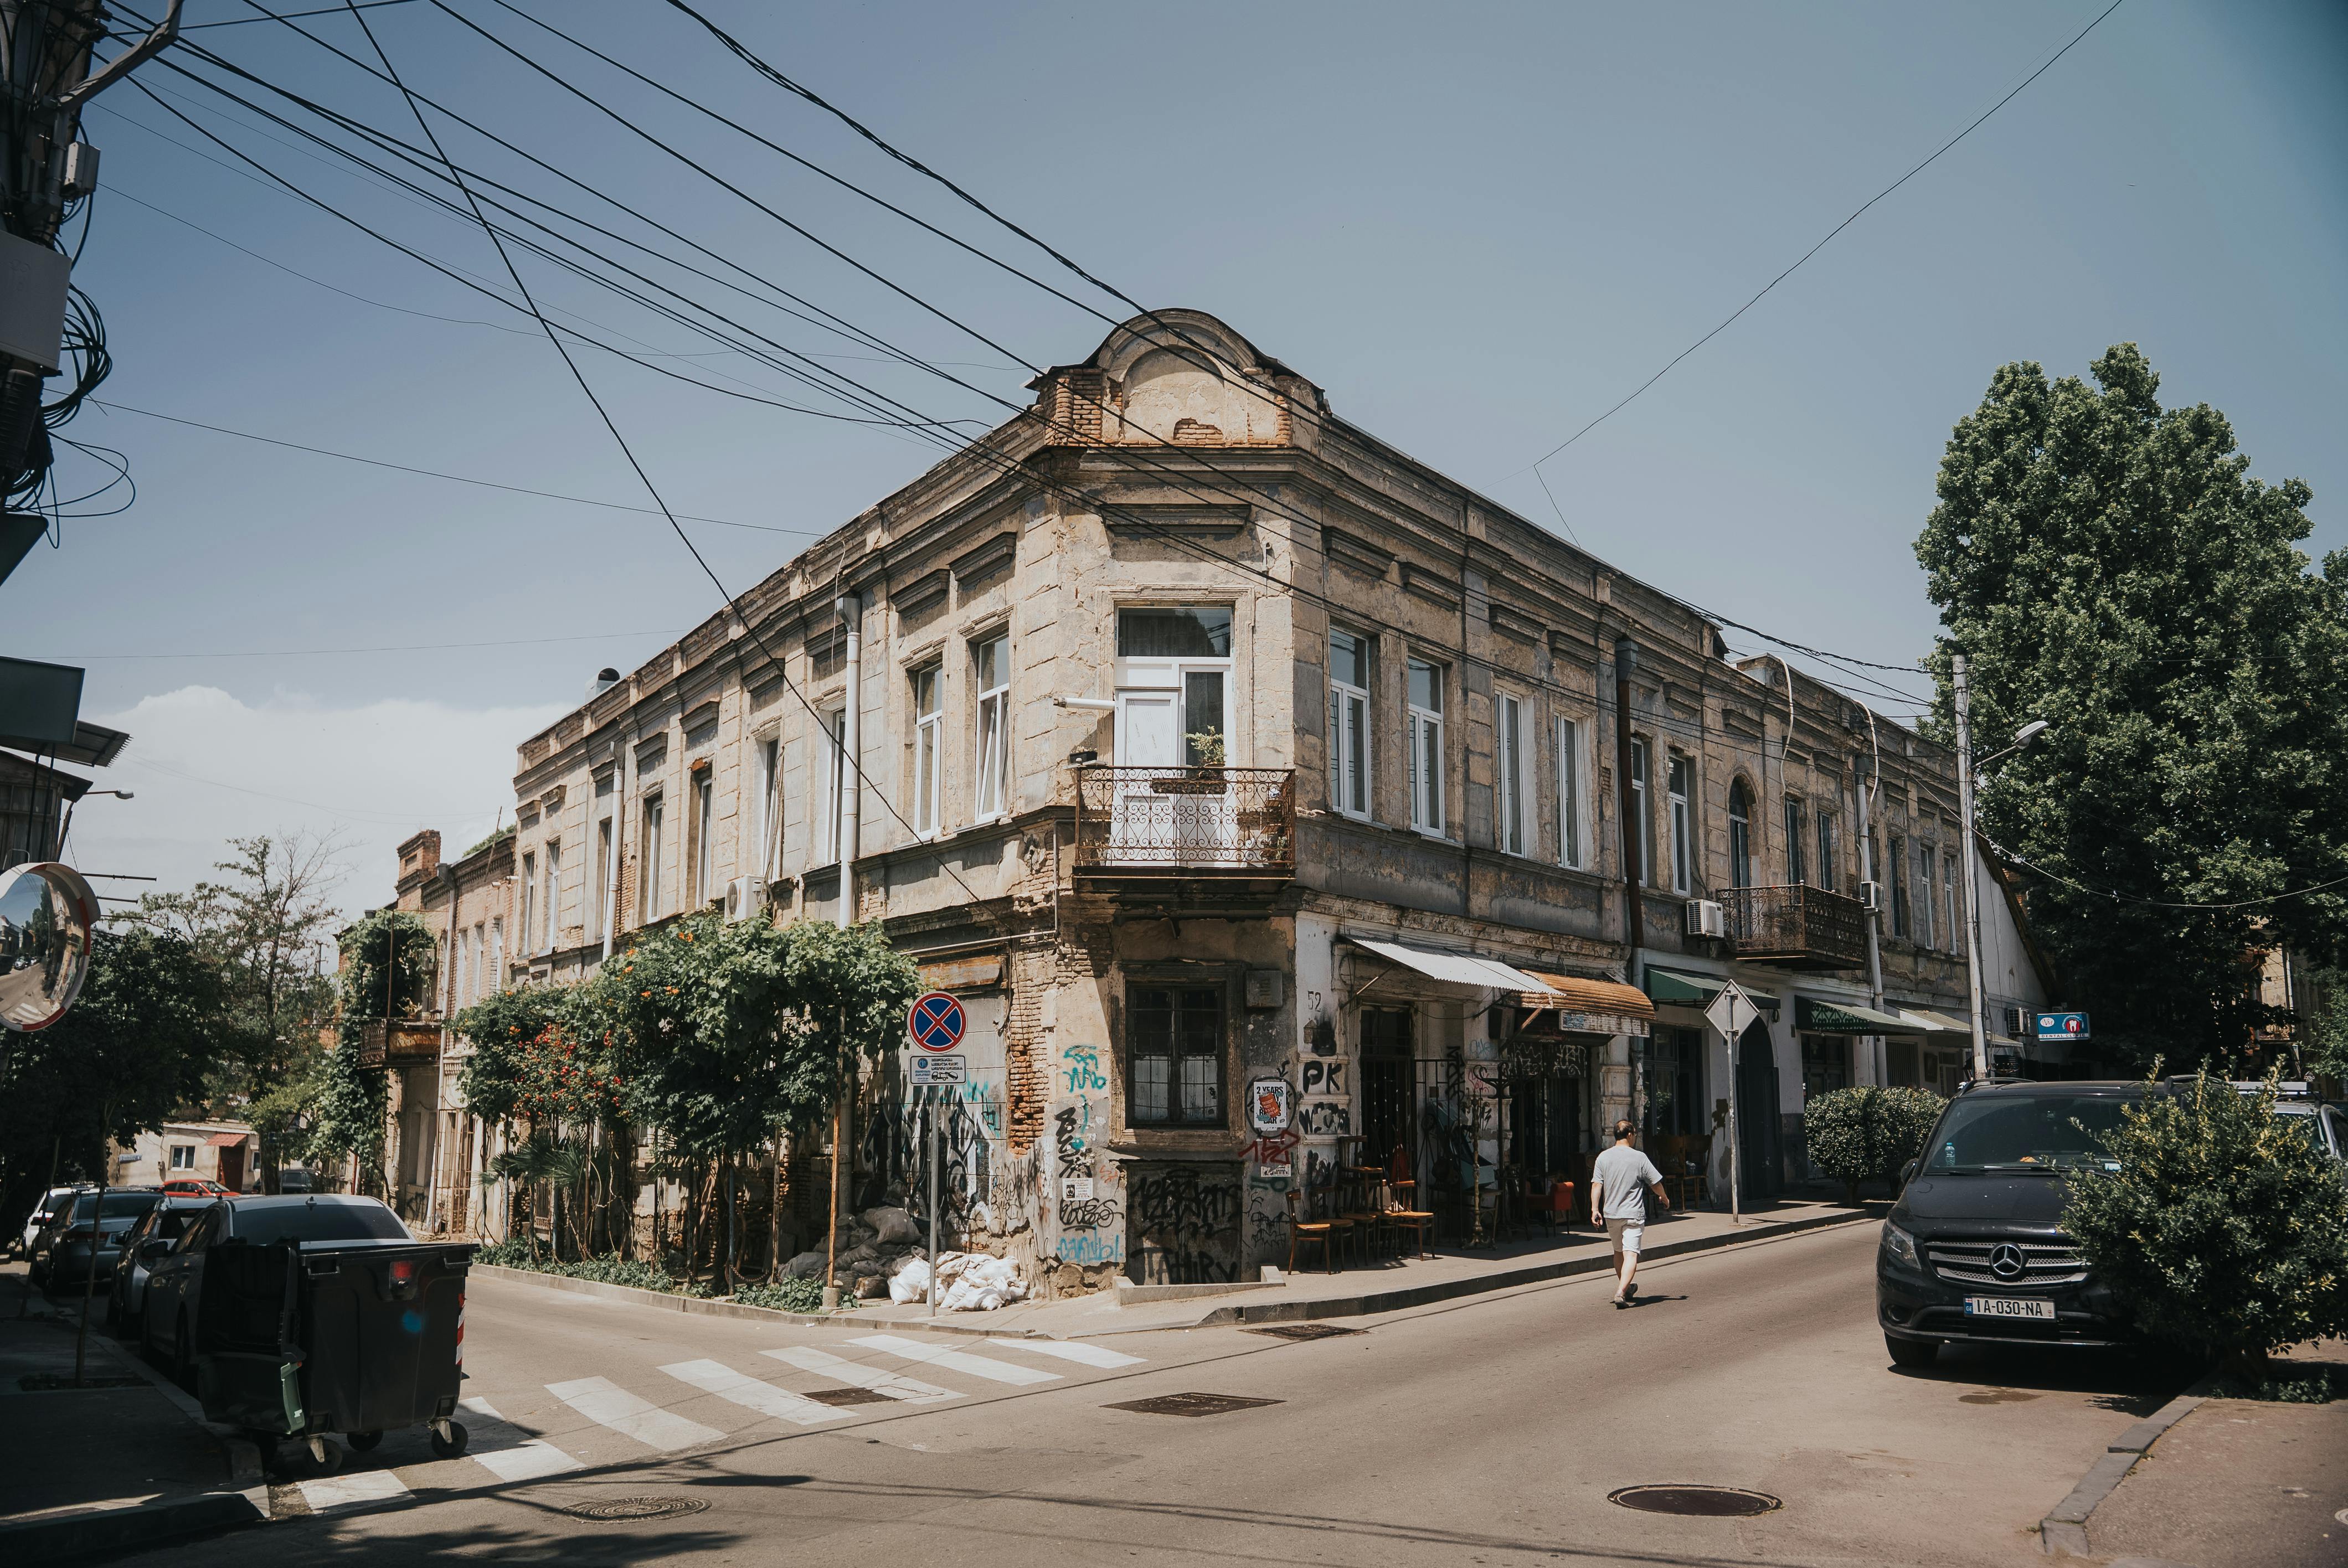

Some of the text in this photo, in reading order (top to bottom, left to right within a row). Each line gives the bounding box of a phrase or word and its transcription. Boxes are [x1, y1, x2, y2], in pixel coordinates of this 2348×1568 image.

[1307, 990, 1322, 1013] 52
[1256, 1086, 1261, 1095] 2
[1262, 1086, 1284, 1094] YEARS
[1976, 1299, 2043, 1317] IA-030-NA
